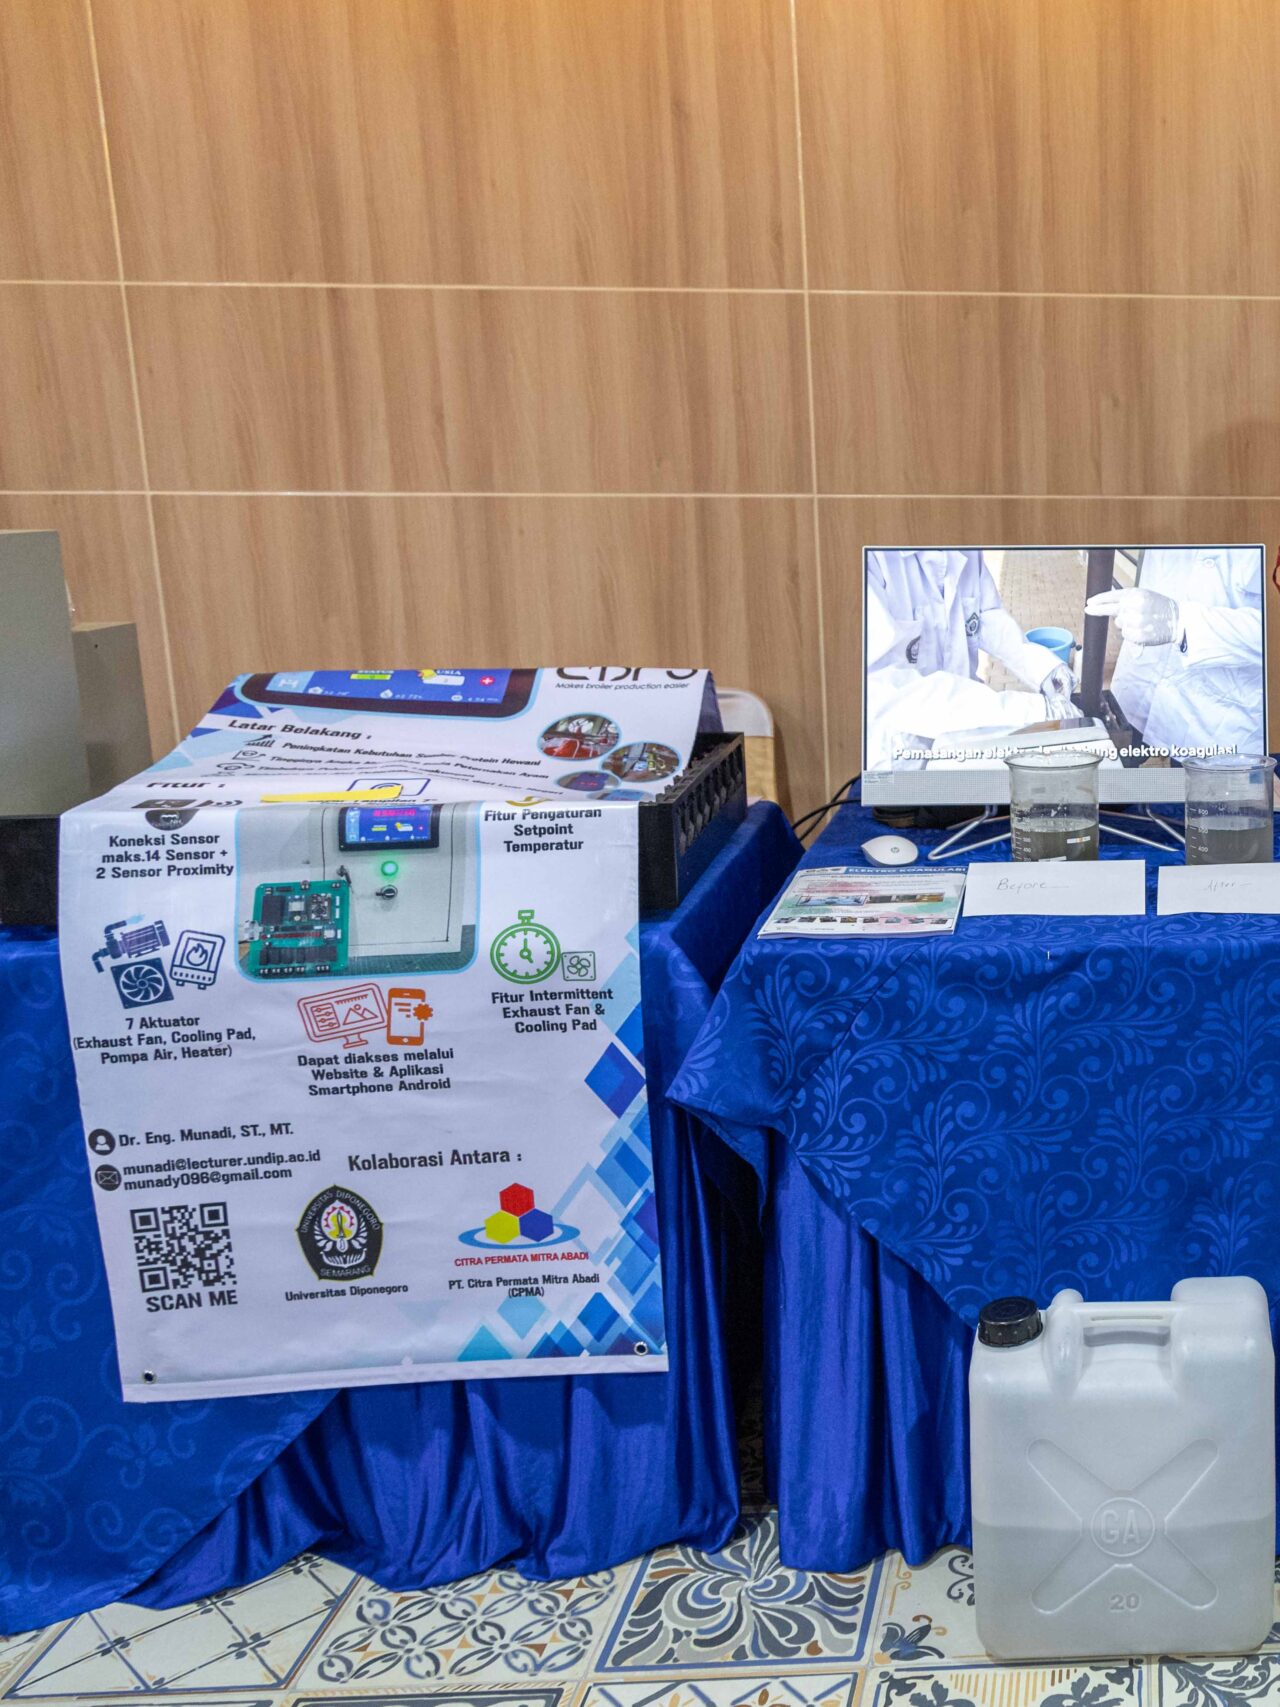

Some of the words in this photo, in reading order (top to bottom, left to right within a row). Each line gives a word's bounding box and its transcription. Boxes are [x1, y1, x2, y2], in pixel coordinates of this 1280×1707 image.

[228, 720, 277, 732] Latar
[280, 724, 363, 740] Belakang
[282, 742, 351, 754] Peningkatan
[354, 748, 412, 758] Kebutuhan
[894, 748, 985, 762] Pemasangan
[1120, 745, 1170, 758] elektro
[1170, 744, 1238, 759] koagulasi
[484, 810, 517, 822] Fitur
[522, 808, 602, 822] Pengaturan
[514, 824, 574, 838] Setpoint
[109, 835, 166, 848] Koneksi
[171, 834, 220, 845] Sensor
[504, 840, 584, 854] Temperatur
[102, 850, 160, 864] maks.14
[166, 850, 216, 861] Sensor
[96, 868, 106, 879] 2
[112, 866, 162, 878] Sensor
[168, 864, 234, 876] Proximity
[491, 992, 524, 1004] Fitur
[530, 988, 614, 1002] Intermittent
[502, 1005, 561, 1018] Exhaust
[565, 1003, 590, 1016] Fan
[594, 1003, 605, 1016] &
[125, 1018, 134, 1030] 7
[140, 1016, 200, 1030] Aktuator
[514, 1020, 568, 1034] Cooling
[572, 1018, 598, 1030] Pad
[72, 1034, 132, 1050] (Exhaust
[137, 1034, 167, 1046] Fan,
[171, 1030, 222, 1044] Cooling
[226, 1028, 256, 1041] Pad,
[100, 1051, 148, 1064] Pompa
[153, 1048, 178, 1061] Air,
[182, 1044, 232, 1059] Heater)
[298, 1054, 340, 1068] Dapat
[344, 1052, 398, 1064] diakses
[404, 1048, 454, 1061] melalui
[312, 1068, 368, 1080] Website
[373, 1066, 384, 1078] &
[389, 1064, 444, 1078] Aplikasi
[308, 1082, 394, 1096] Smartphone
[398, 1078, 451, 1092] Android
[118, 1134, 141, 1148] Dr.
[145, 1131, 176, 1146] Eng.
[180, 1126, 236, 1142] Munadi,
[240, 1124, 266, 1138] ST.,
[270, 1122, 294, 1136] MT.
[123, 1149, 321, 1176] munadi@lecturer.undip.ac.id
[348, 1152, 444, 1172] Kolaborasi
[450, 1150, 510, 1166] Antara
[124, 1168, 292, 1190] munady096@gmail.com
[300, 1190, 334, 1233] UNIVERSITAS
[336, 1190, 380, 1231] DIPONEGORO
[454, 1256, 484, 1267] CITRA
[484, 1254, 529, 1265] PERMATA
[530, 1252, 560, 1262] MITRA
[560, 1252, 590, 1260] ABADI
[320, 1264, 371, 1277] SEMARANG
[448, 1280, 464, 1290] PT.
[468, 1278, 493, 1289] Citra
[496, 1276, 540, 1287] Permata
[542, 1274, 569, 1285] Mitra
[572, 1274, 600, 1284] Abadi
[285, 1288, 346, 1302] Universitas
[349, 1284, 409, 1297] Diponegoro
[508, 1286, 545, 1298] (CPMA)
[146, 1292, 203, 1314] SCAN
[209, 1290, 238, 1307] ME
[1100, 1509, 1143, 1546] GA
[1109, 1593, 1140, 1612] 20
